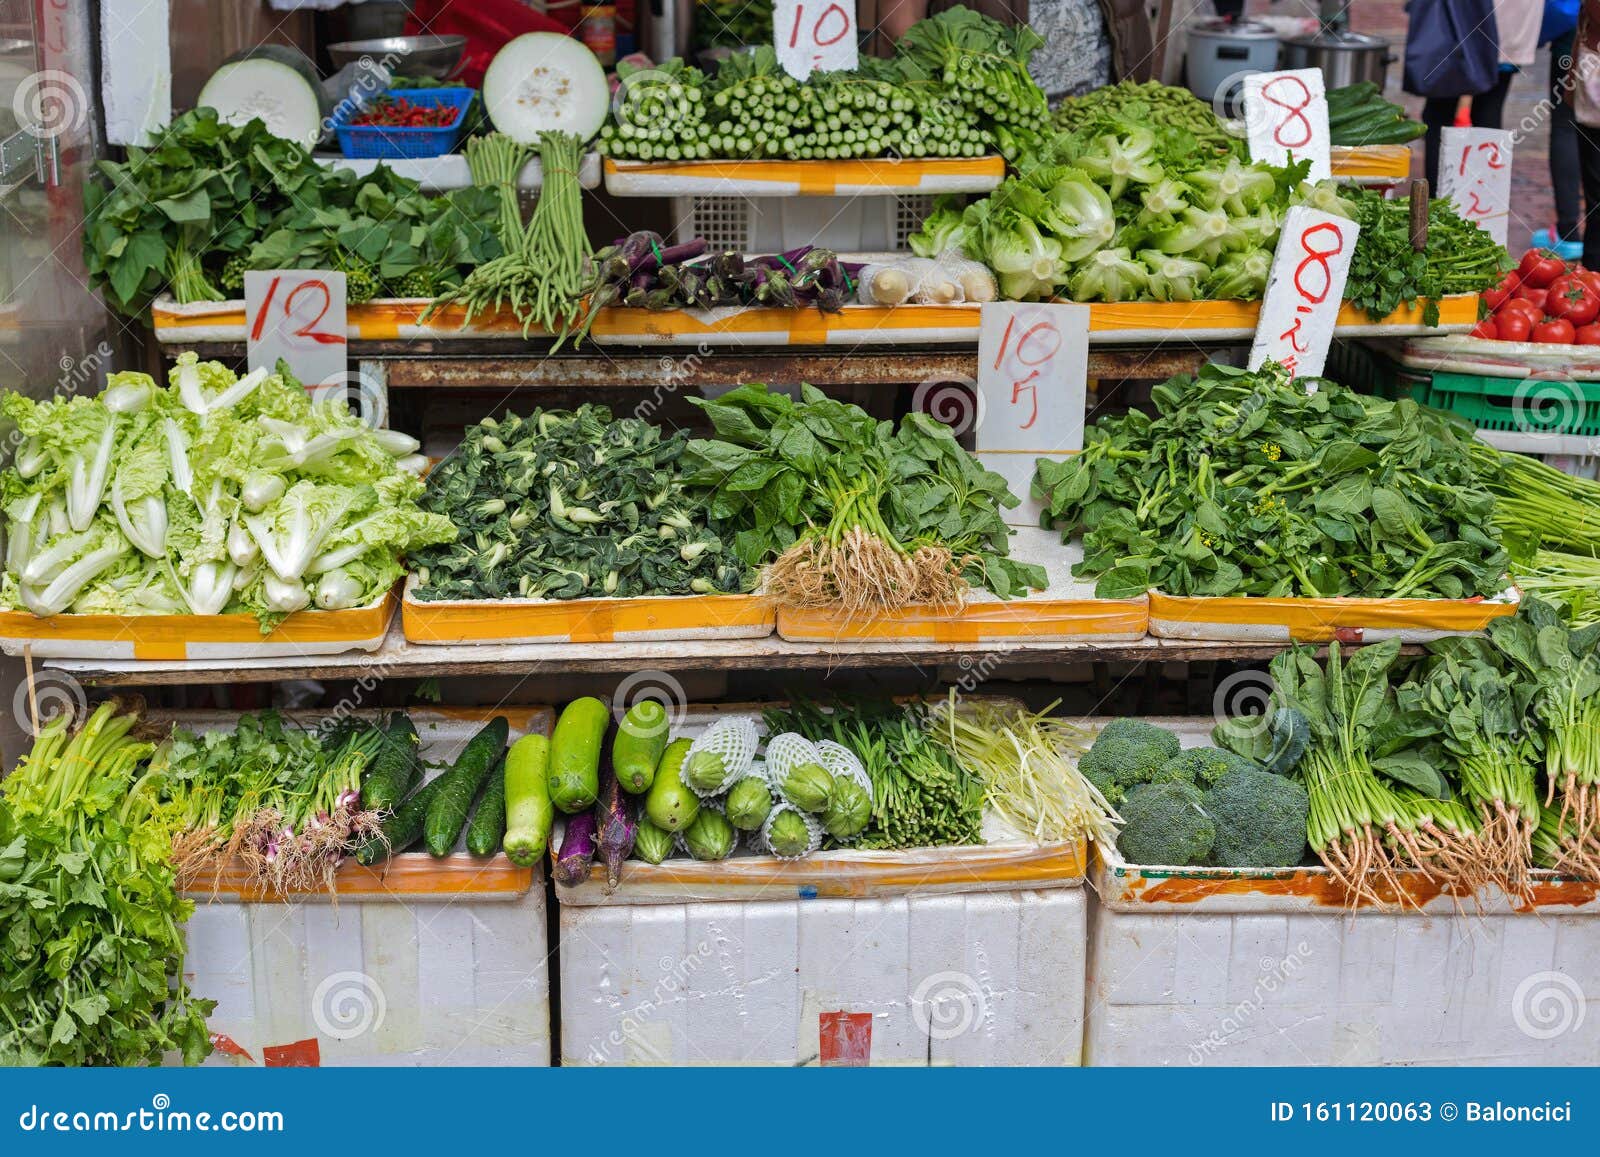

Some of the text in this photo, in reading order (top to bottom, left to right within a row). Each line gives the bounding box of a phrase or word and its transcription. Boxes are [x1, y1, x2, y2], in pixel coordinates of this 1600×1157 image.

[787, 3, 847, 48] 10
[1261, 75, 1312, 148] 8
[1459, 141, 1505, 177] 12
[1294, 222, 1344, 304] 8
[251, 275, 346, 344] 12
[994, 314, 1062, 370] 10
